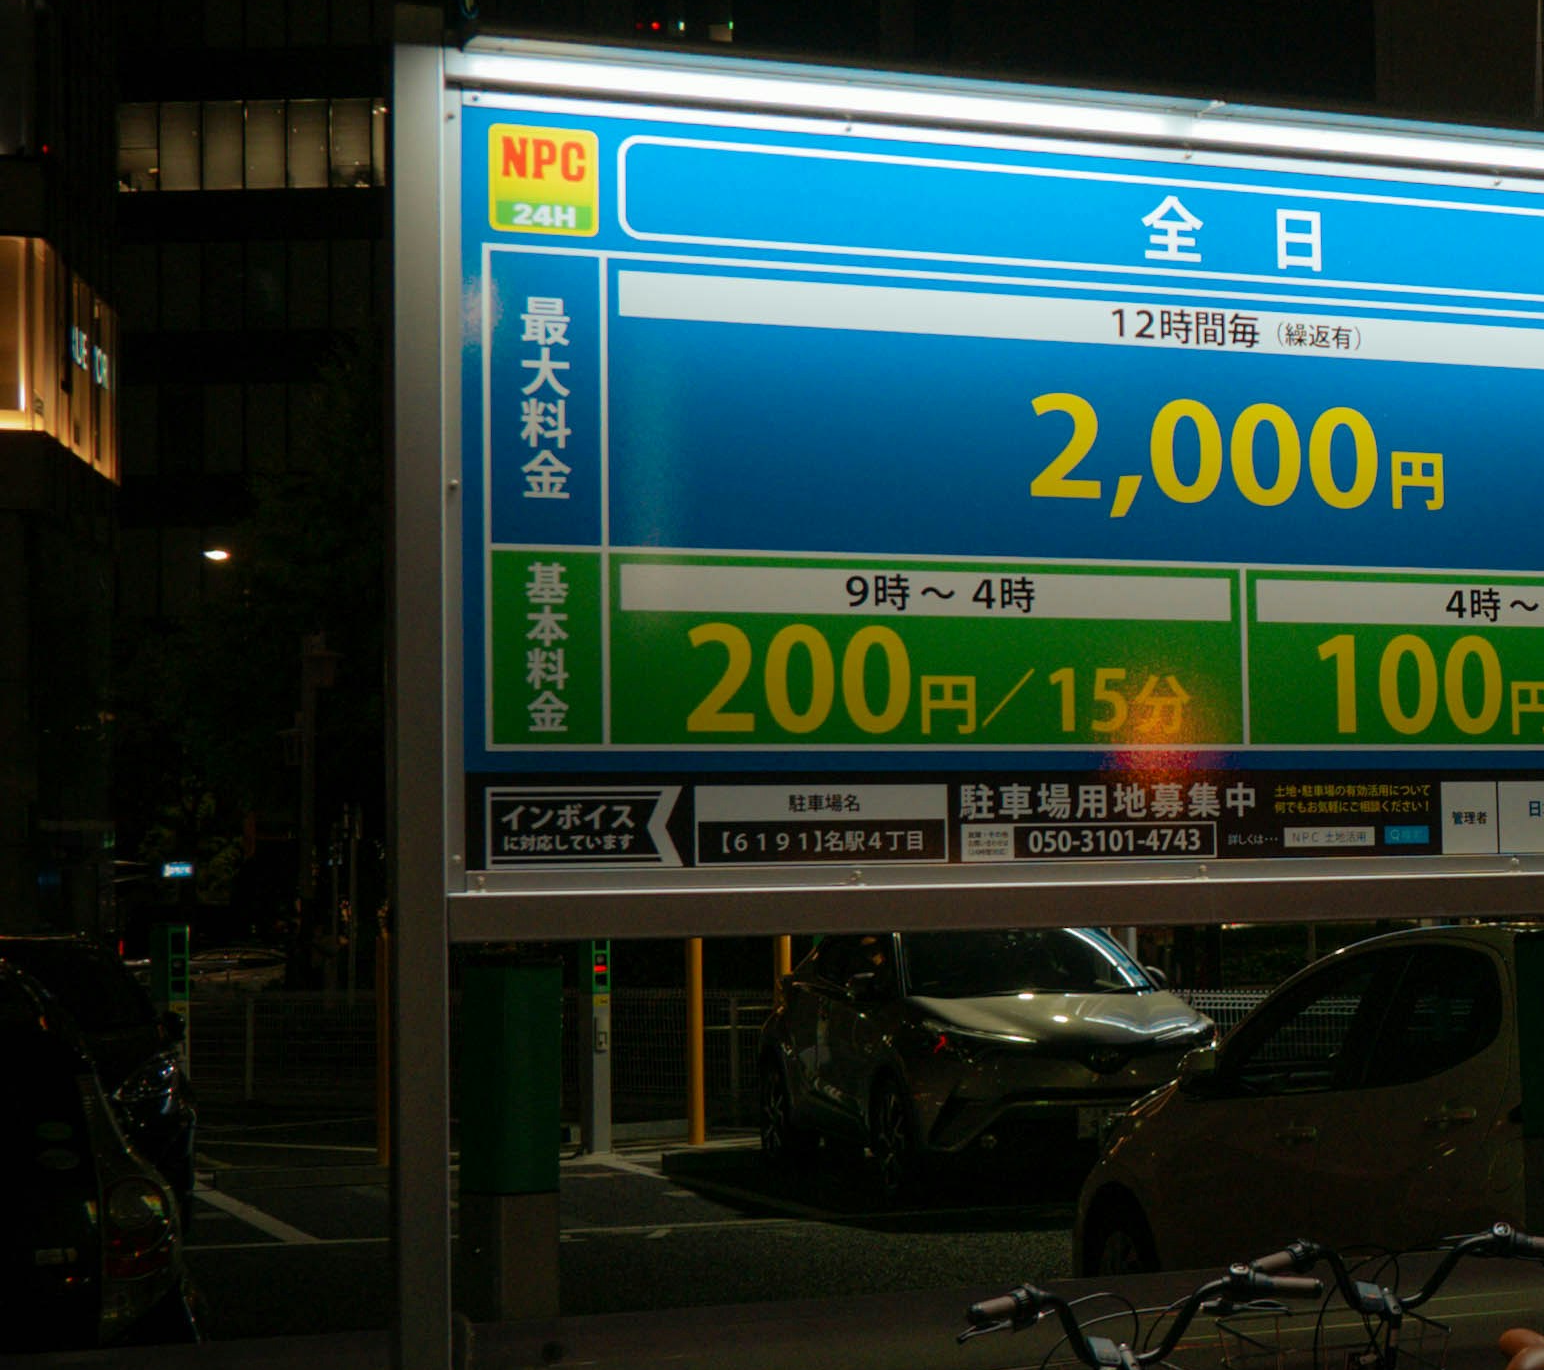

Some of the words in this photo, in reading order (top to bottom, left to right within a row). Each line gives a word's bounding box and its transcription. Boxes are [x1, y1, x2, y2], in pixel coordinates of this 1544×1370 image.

[501, 135, 586, 183] NPC
[512, 202, 577, 229] 24H
[520, 296, 572, 499] 最大料金
[1029, 392, 1445, 519] 2,000円
[526, 562, 569, 733] 基本料金
[788, 793, 861, 814] 駐車場名
[958, 781, 1257, 822] 駐車場用地募集中
[501, 804, 635, 831] インボイス
[1451, 811, 1487, 825] 管理者
[503, 832, 635, 853] に対応しています
[1028, 829, 1201, 853] 050-3101-4743
